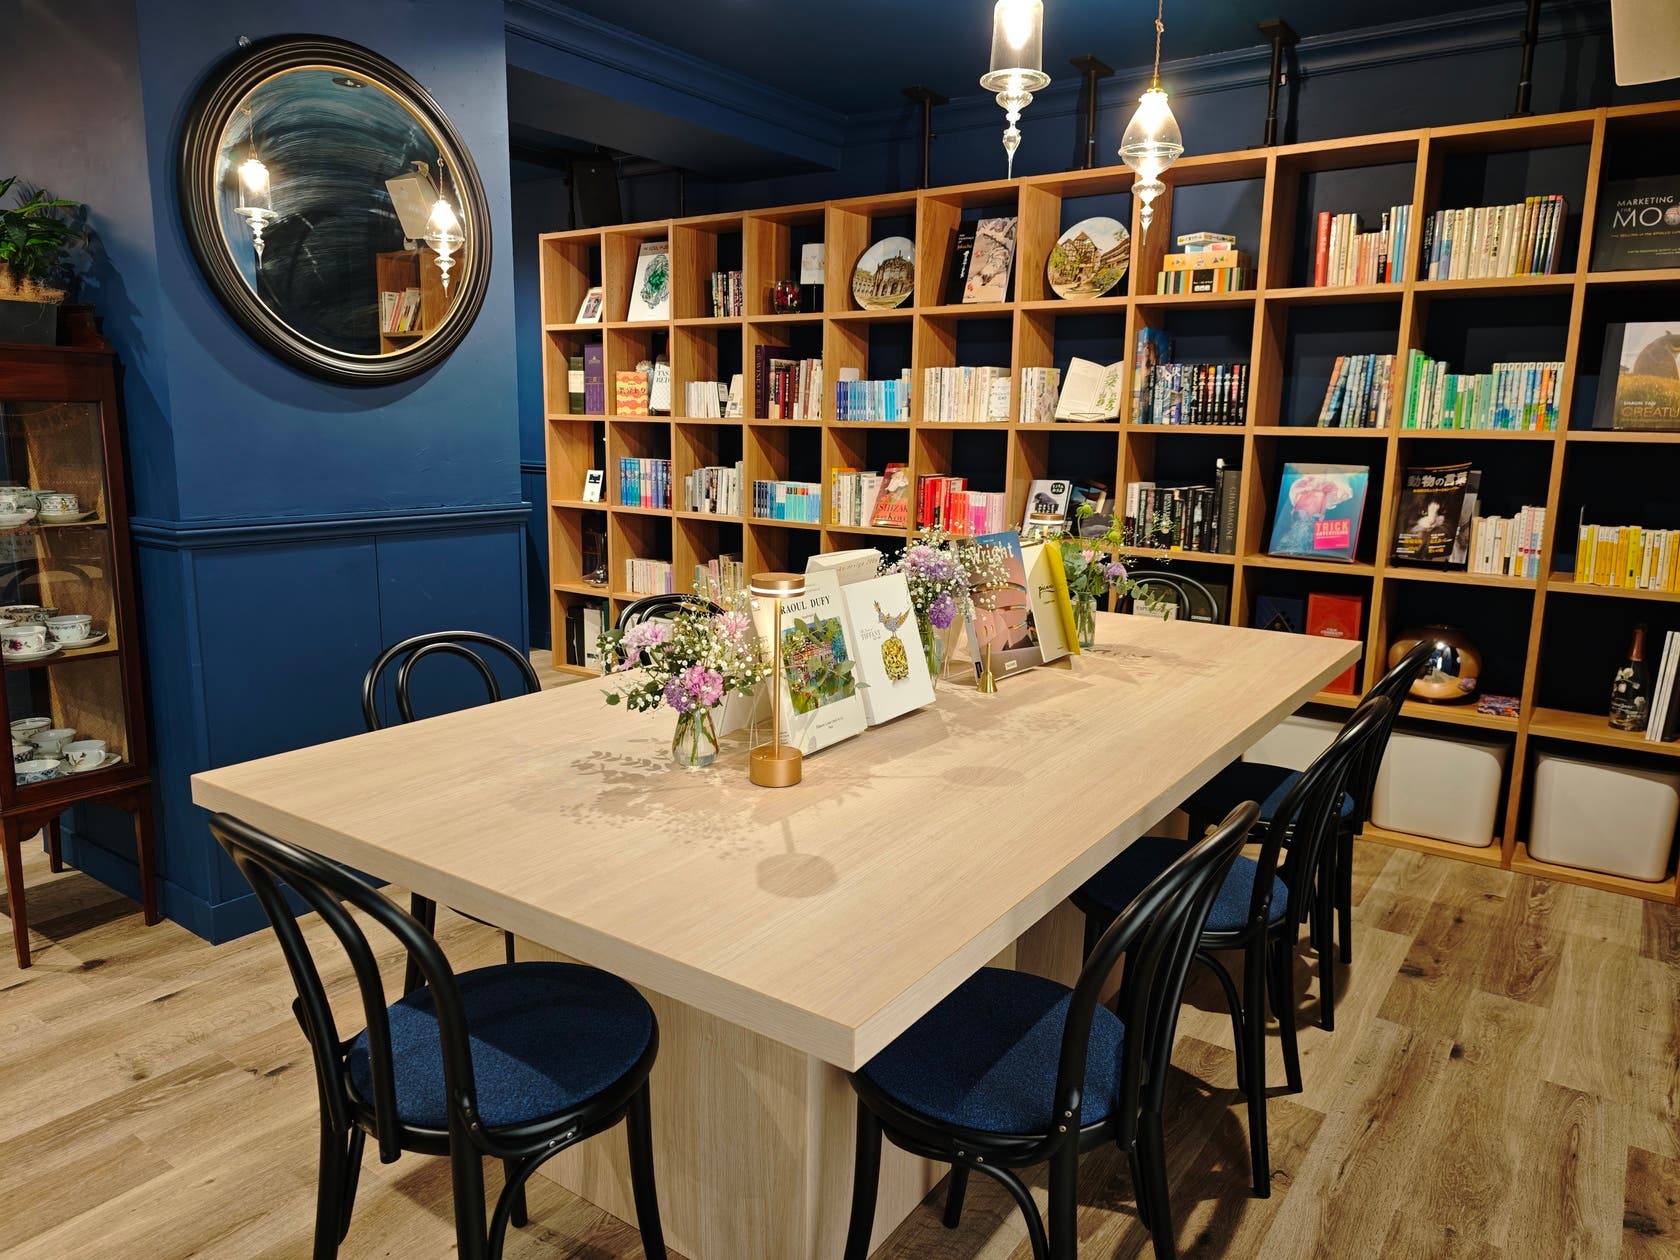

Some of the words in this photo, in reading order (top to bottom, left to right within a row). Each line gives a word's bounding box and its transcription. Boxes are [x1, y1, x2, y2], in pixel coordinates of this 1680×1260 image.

[1616, 195, 1674, 207] MARKETING
[1315, 520, 1349, 532] TRICK
[780, 601, 807, 615] RAOUL
[809, 595, 830, 608] DUFY
